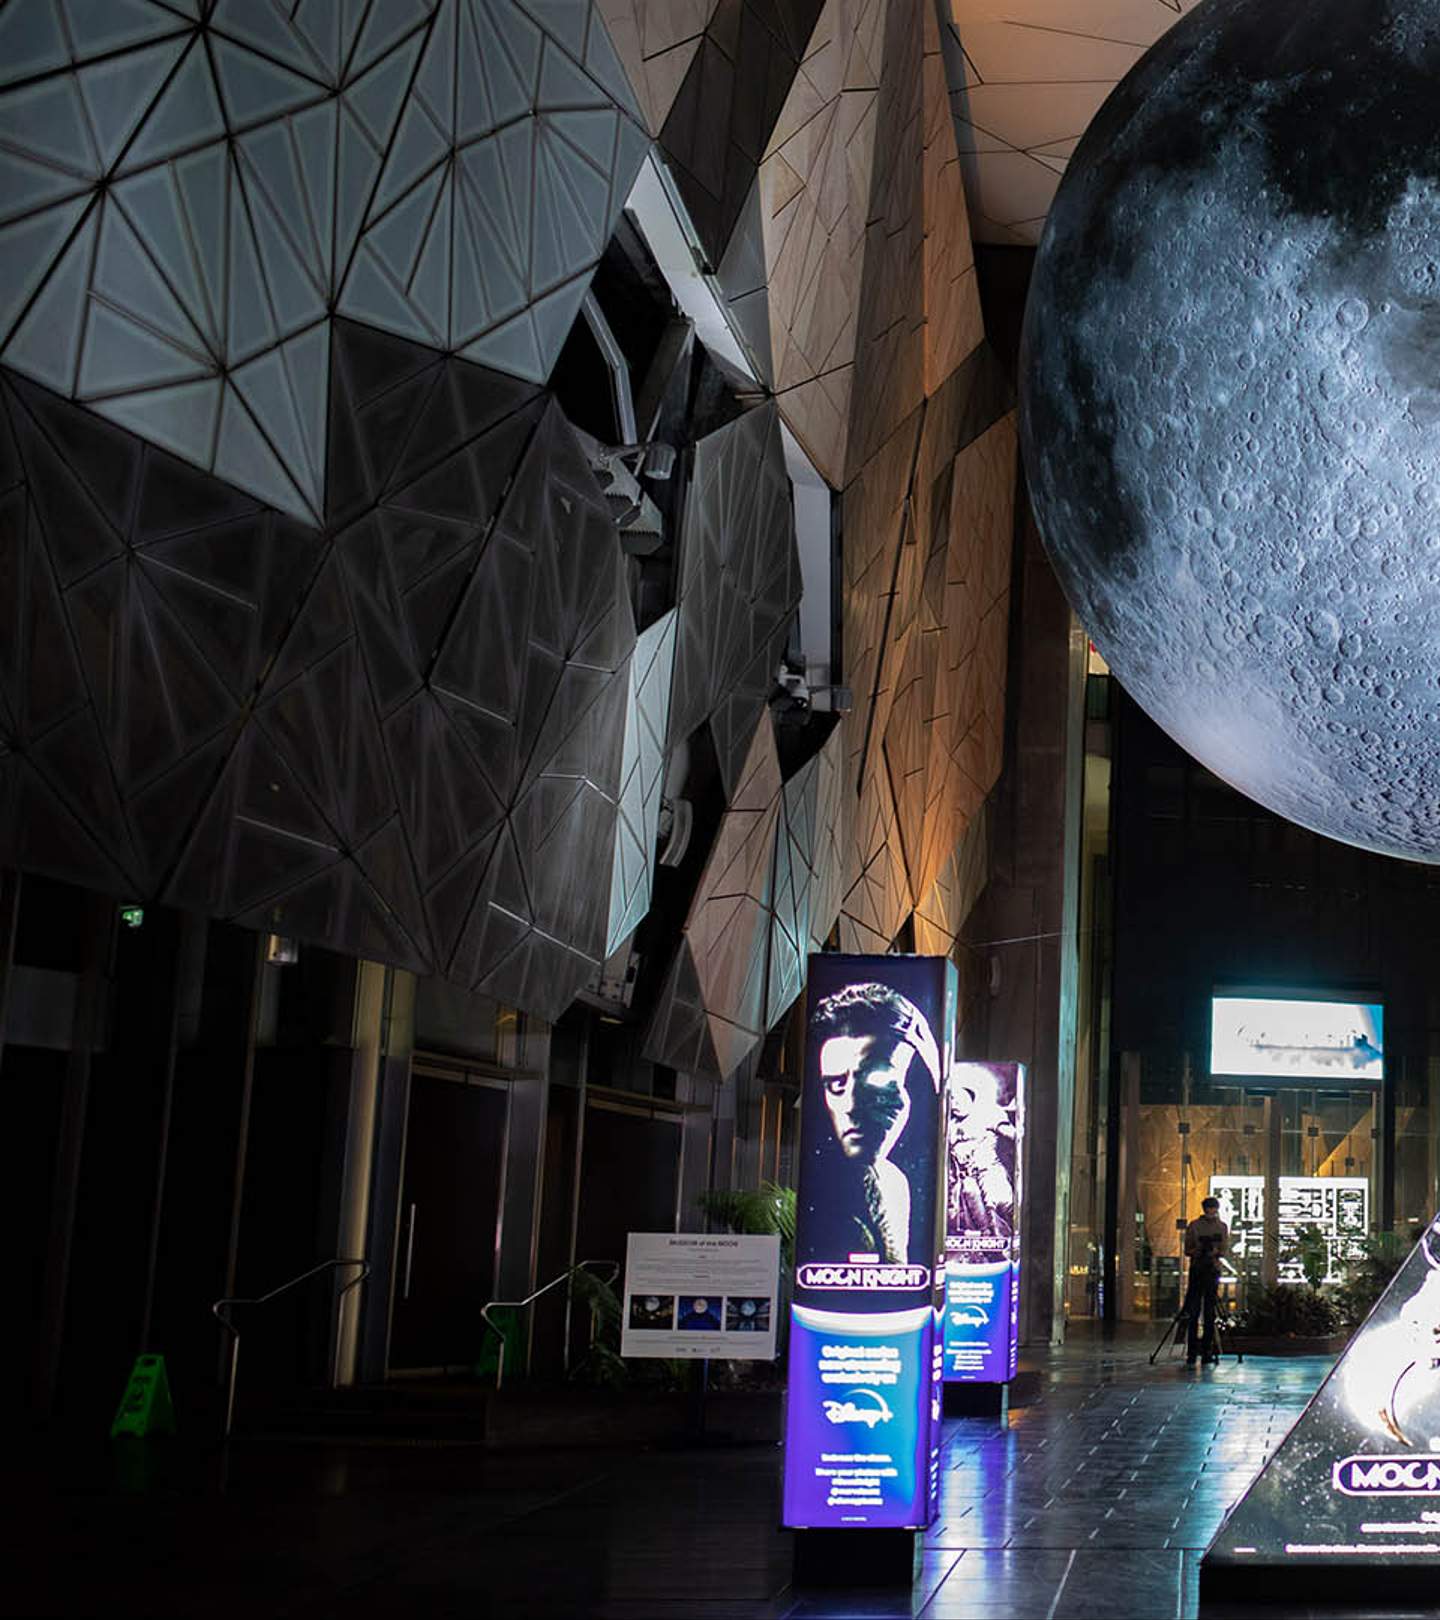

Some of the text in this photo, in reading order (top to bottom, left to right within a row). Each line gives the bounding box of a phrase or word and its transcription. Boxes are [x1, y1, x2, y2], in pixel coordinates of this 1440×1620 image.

[972, 1238, 1005, 1250] KNIGHT
[806, 1268, 923, 1288] MOON KNIGHT
